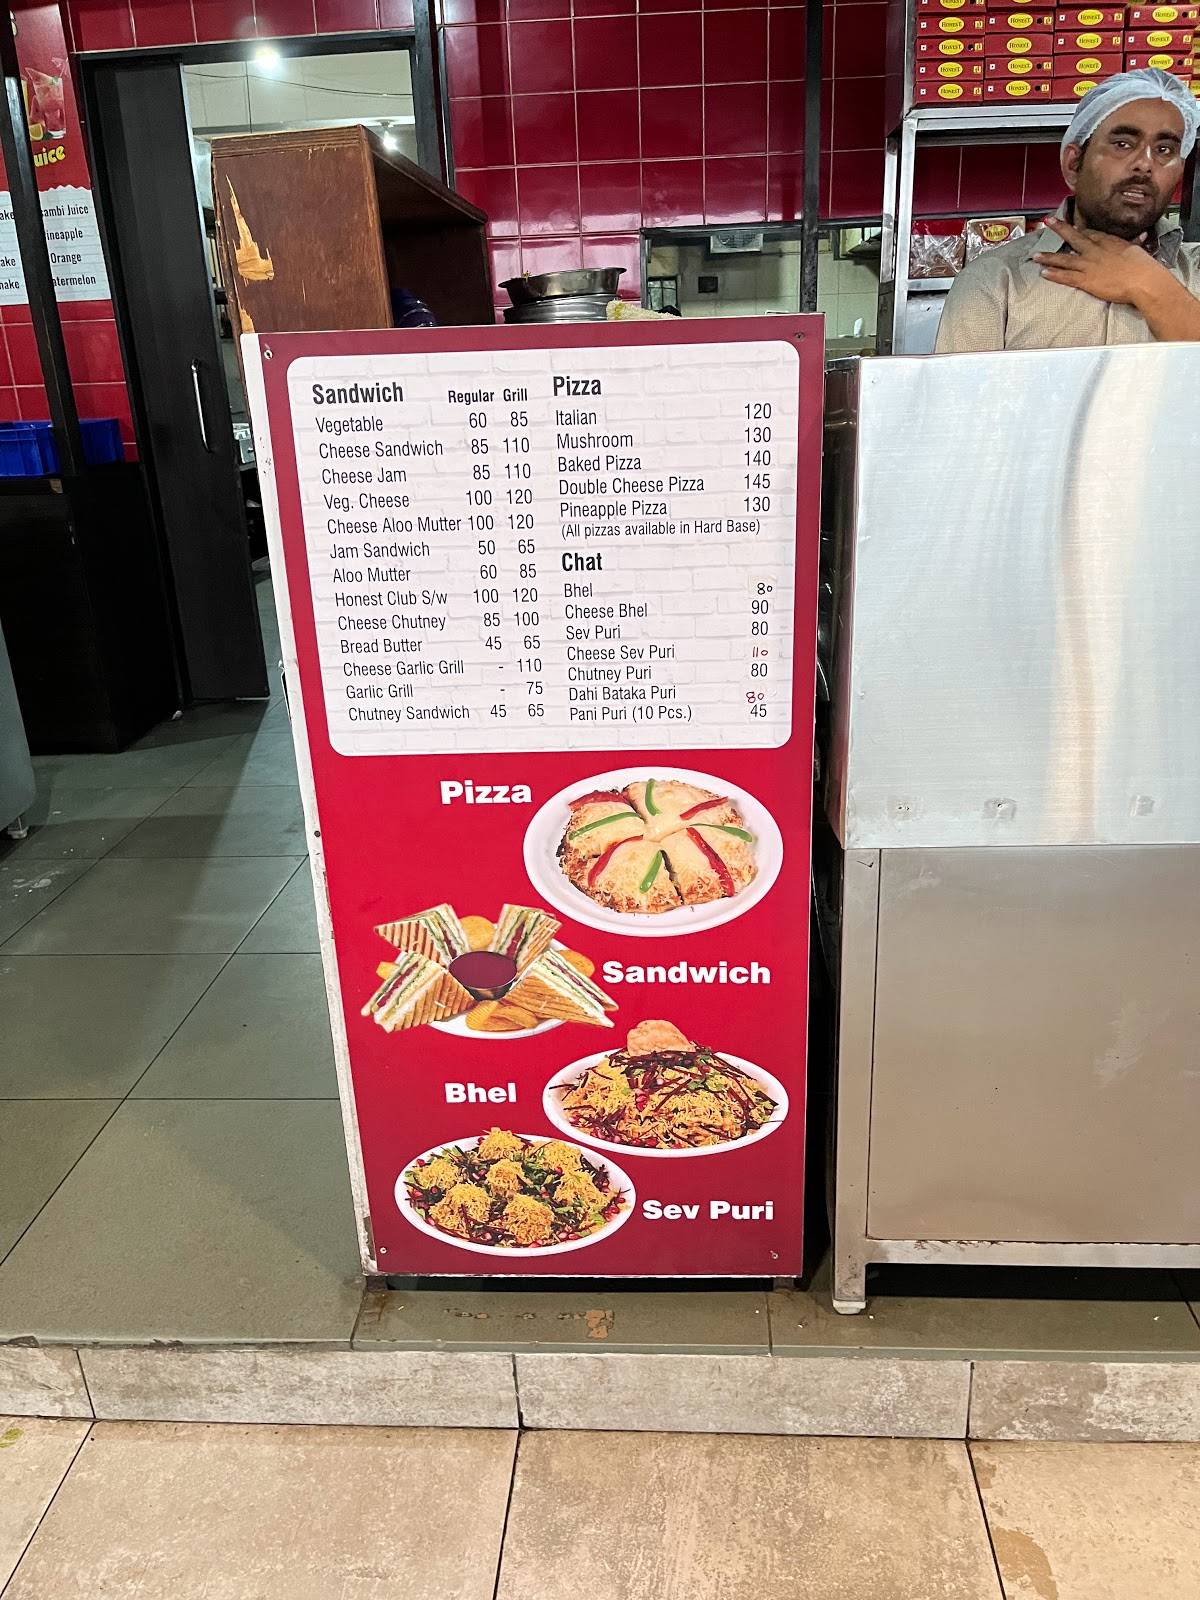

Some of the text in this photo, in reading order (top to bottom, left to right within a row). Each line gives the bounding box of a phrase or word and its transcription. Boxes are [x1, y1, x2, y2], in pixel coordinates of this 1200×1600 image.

[33, 146, 66, 167] uice
[68, 204, 88, 215] Juice
[47, 228, 83, 241] ineapple
[51, 253, 81, 264] Orange
[313, 382, 403, 404] Sandwich
[553, 376, 601, 396] Pizza
[448, 388, 527, 405] Regular Grill
[316, 411, 528, 435] Vegetable 60 85
[556, 403, 771, 425] Italian 120
[557, 427, 771, 449] Mushroom 130
[320, 438, 529, 458] Cheese Sandwich 85 110
[559, 450, 770, 472] Baked Pizza 140
[322, 464, 530, 484] Cheese Jam 85 110
[560, 474, 770, 494] Double Cheese Pizza 145
[324, 489, 532, 512] Veg. Cheese 100 120
[561, 497, 770, 519] Pineapple Pizza 130
[328, 514, 533, 534] Cheese Aloo Mutter 100 120
[562, 519, 760, 540] (All pizzas available in Hard Base)
[330, 539, 535, 558] Jam Sandwich 50 65
[562, 553, 602, 571] Chat
[334, 564, 536, 582] Aloo Mutter 60 85
[336, 588, 537, 606] Honest Club S/w 100 120
[565, 583, 592, 597] Bhel
[566, 600, 768, 619] Cheese Bhel 90
[338, 612, 539, 631] Cheese Chutney 85 100
[567, 621, 768, 640] Sev Puri 80
[341, 636, 540, 653] Bread Butter 45 65
[568, 645, 674, 660] Cheese Sev Puri
[344, 663, 391, 676] Cheese
[397, 661, 433, 675] Garlic
[439, 660, 463, 674] Grill
[518, 659, 541, 672] 110
[569, 663, 767, 683] Chutney Puri 80
[346, 685, 383, 698] Garlic
[389, 684, 413, 697] Grill
[526, 681, 543, 694] 75
[569, 685, 675, 700] Dahi Bataka Puri
[349, 704, 544, 722] Chutney Sandwich 45 65
[570, 703, 767, 722] Pani Puri (10 Pcs.) 45
[440, 780, 532, 805] Pizza
[602, 961, 771, 984] Sandwich
[444, 1083, 517, 1104] Bhel
[642, 1199, 774, 1221] Sev Puri
